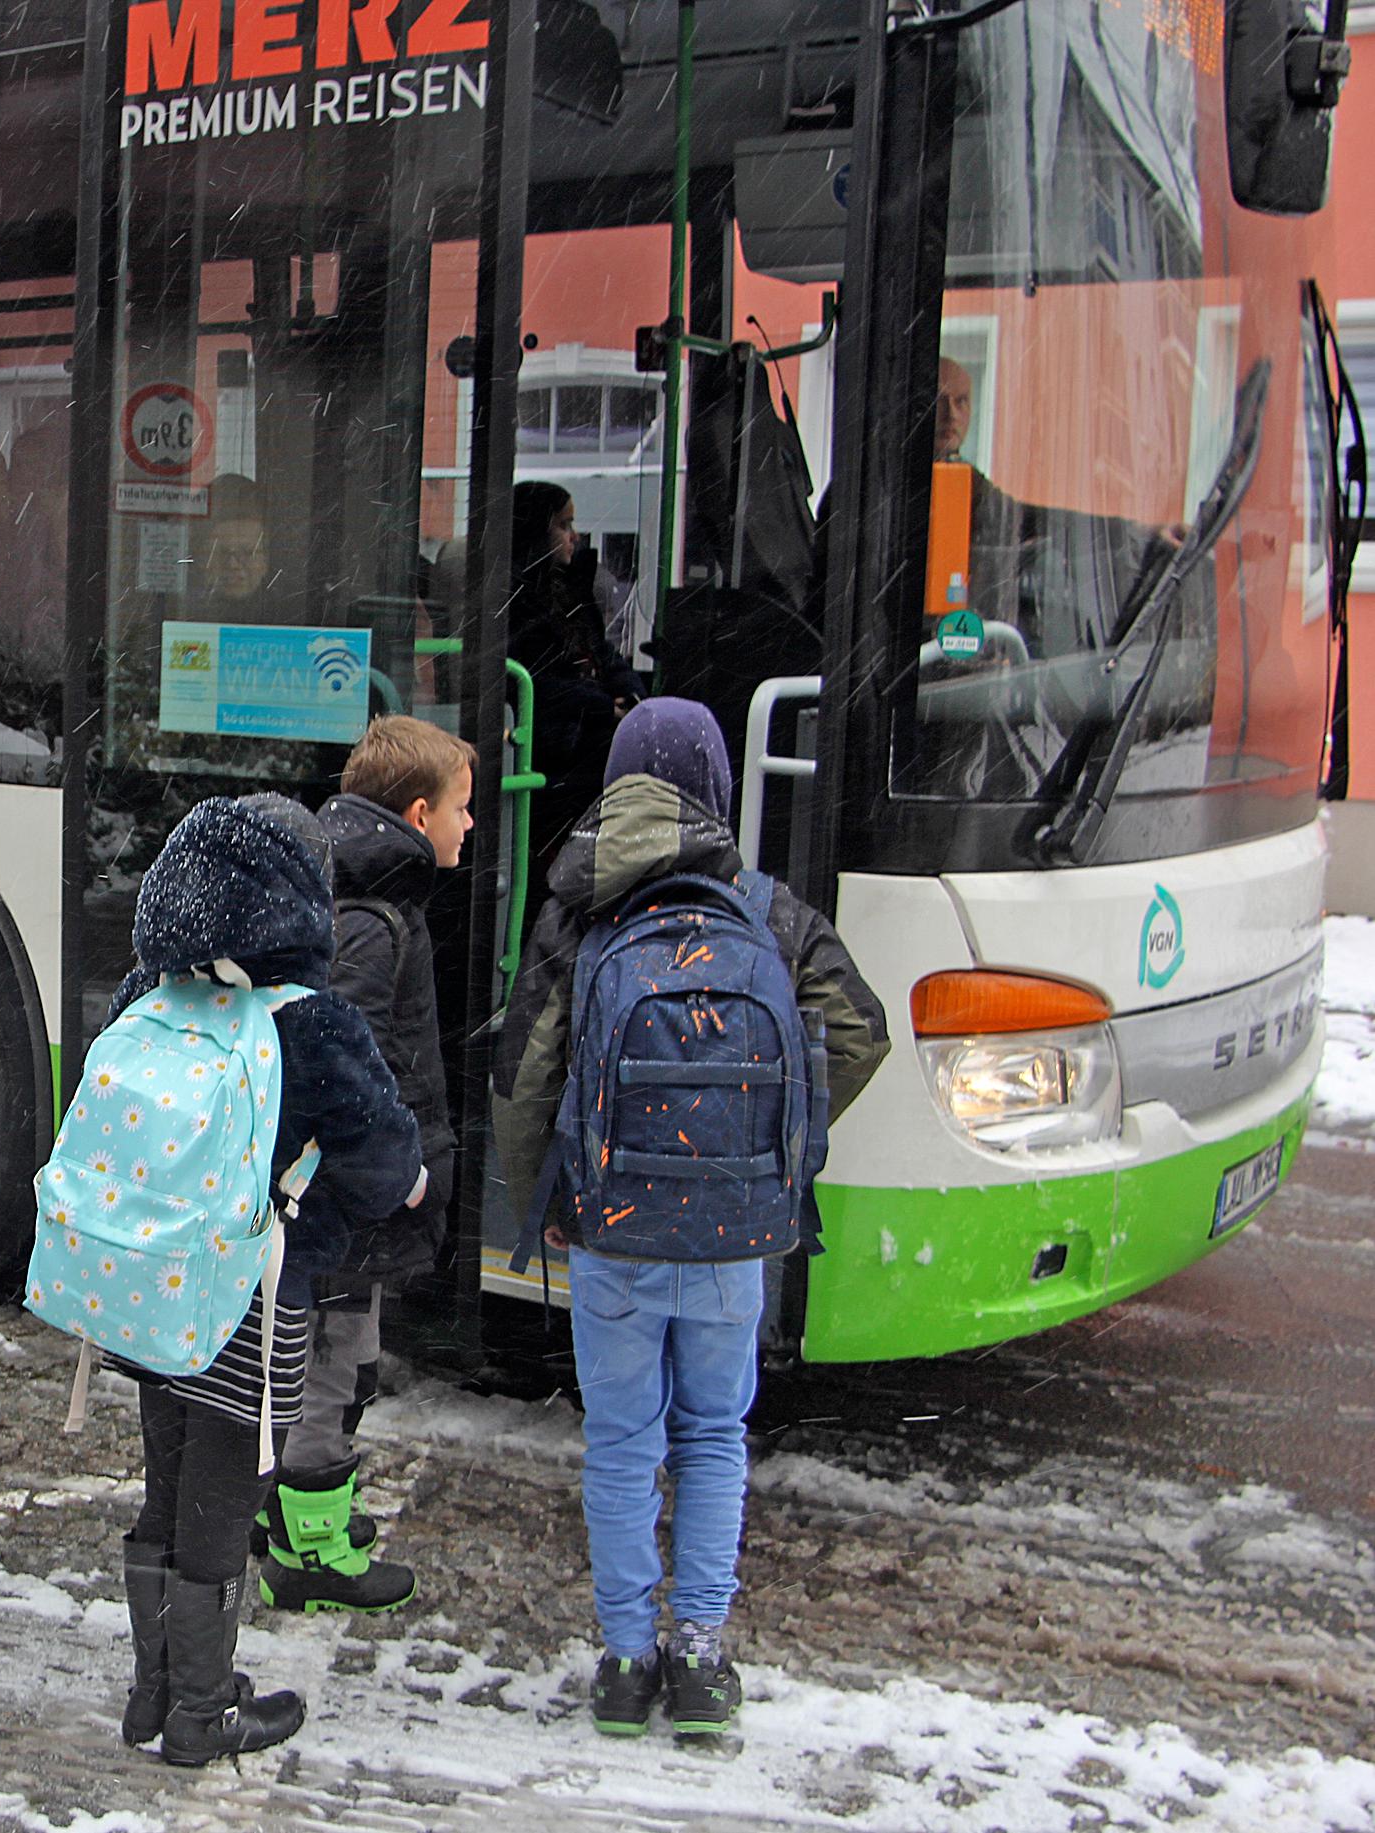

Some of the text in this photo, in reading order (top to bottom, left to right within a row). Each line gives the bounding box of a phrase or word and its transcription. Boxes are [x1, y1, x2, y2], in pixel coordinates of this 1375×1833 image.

[125, 0, 489, 96] MERZ
[120, 61, 488, 148] PREMIUM REISEN
[955, 613, 968, 635] 4
[224, 664, 312, 703] WLAN
[1148, 930, 1174, 953] VGN
